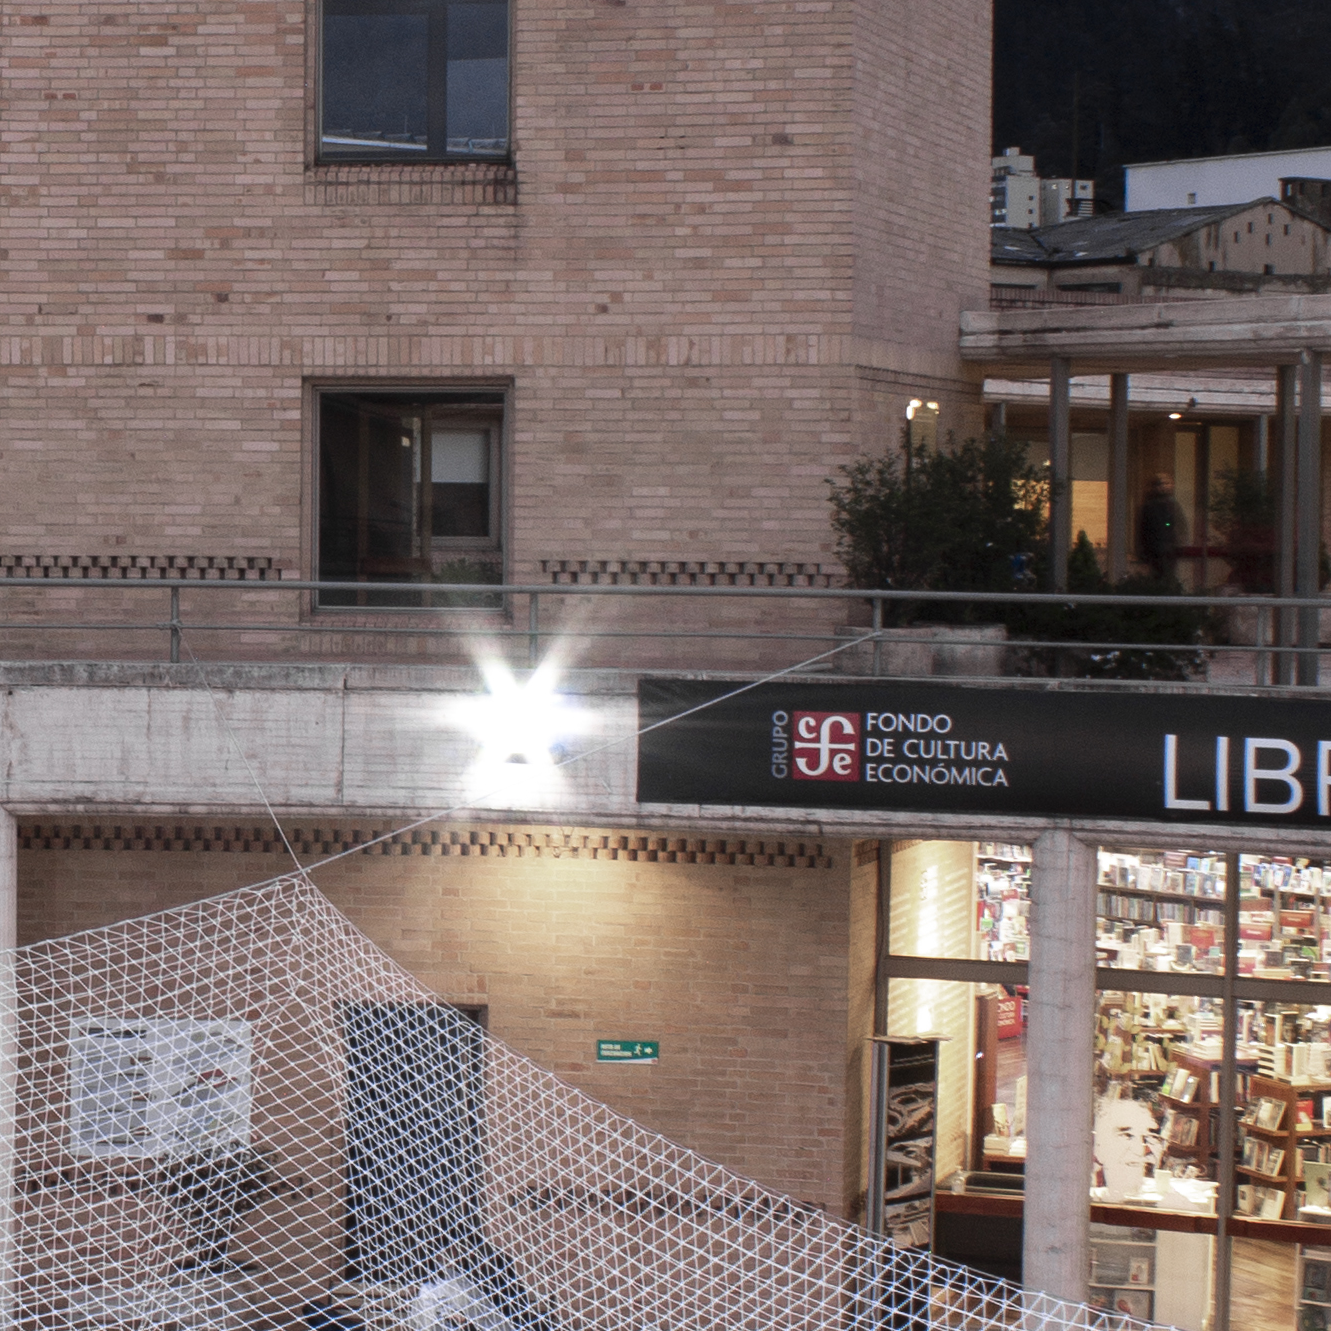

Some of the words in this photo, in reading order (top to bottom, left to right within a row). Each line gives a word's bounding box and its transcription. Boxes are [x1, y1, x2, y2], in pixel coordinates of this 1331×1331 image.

[866, 712, 952, 734] FONDO
[771, 710, 789, 779] GRUPO
[866, 737, 896, 758] DE
[903, 738, 1010, 762] CULTURA
[865, 762, 1010, 787] ECONÓMICA
[1164, 734, 1331, 816] LIB
